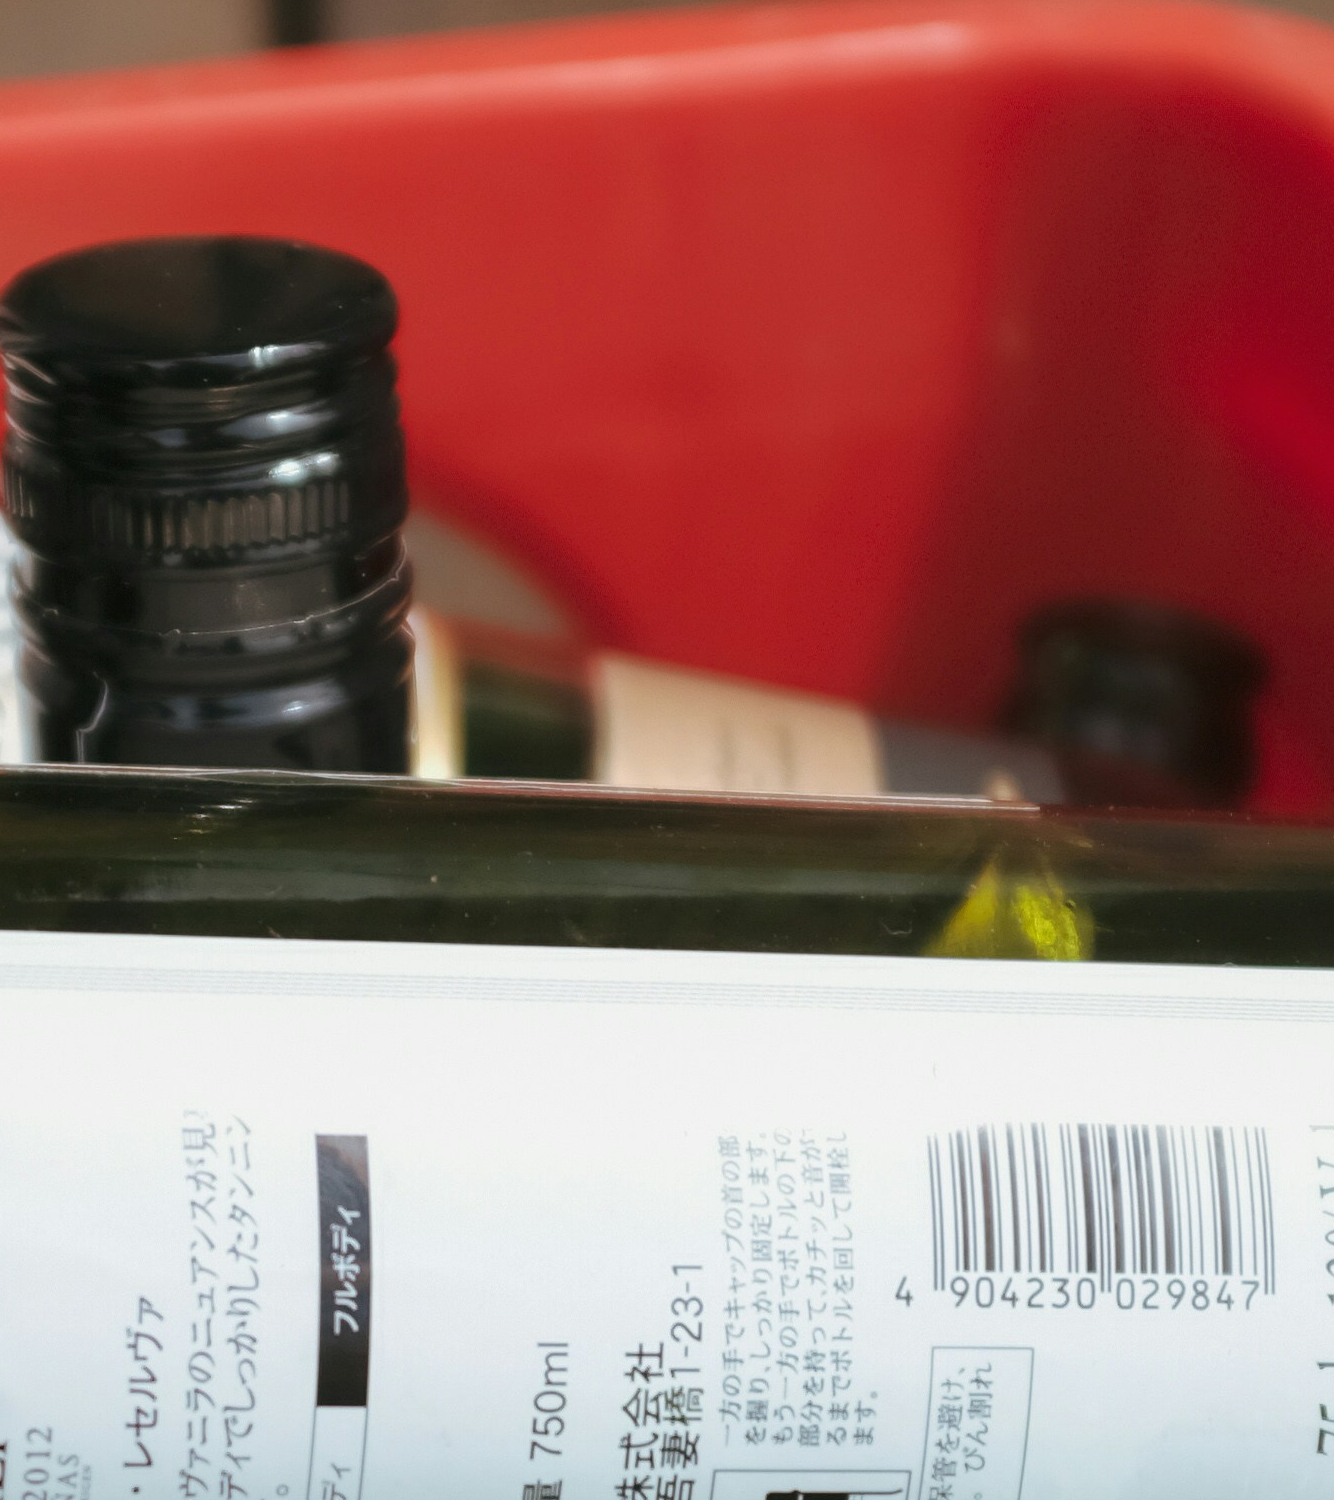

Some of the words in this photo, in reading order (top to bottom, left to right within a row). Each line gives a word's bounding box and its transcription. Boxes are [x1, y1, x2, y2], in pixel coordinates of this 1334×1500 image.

[330, 1204, 362, 1336] フルボディ
[894, 1275, 914, 1308] 4
[949, 1275, 1097, 1310] 904230
[1114, 1277, 1261, 1311] 029847
[529, 1341, 569, 1462] 750ml
[852, 1391, 878, 1446] ます。
